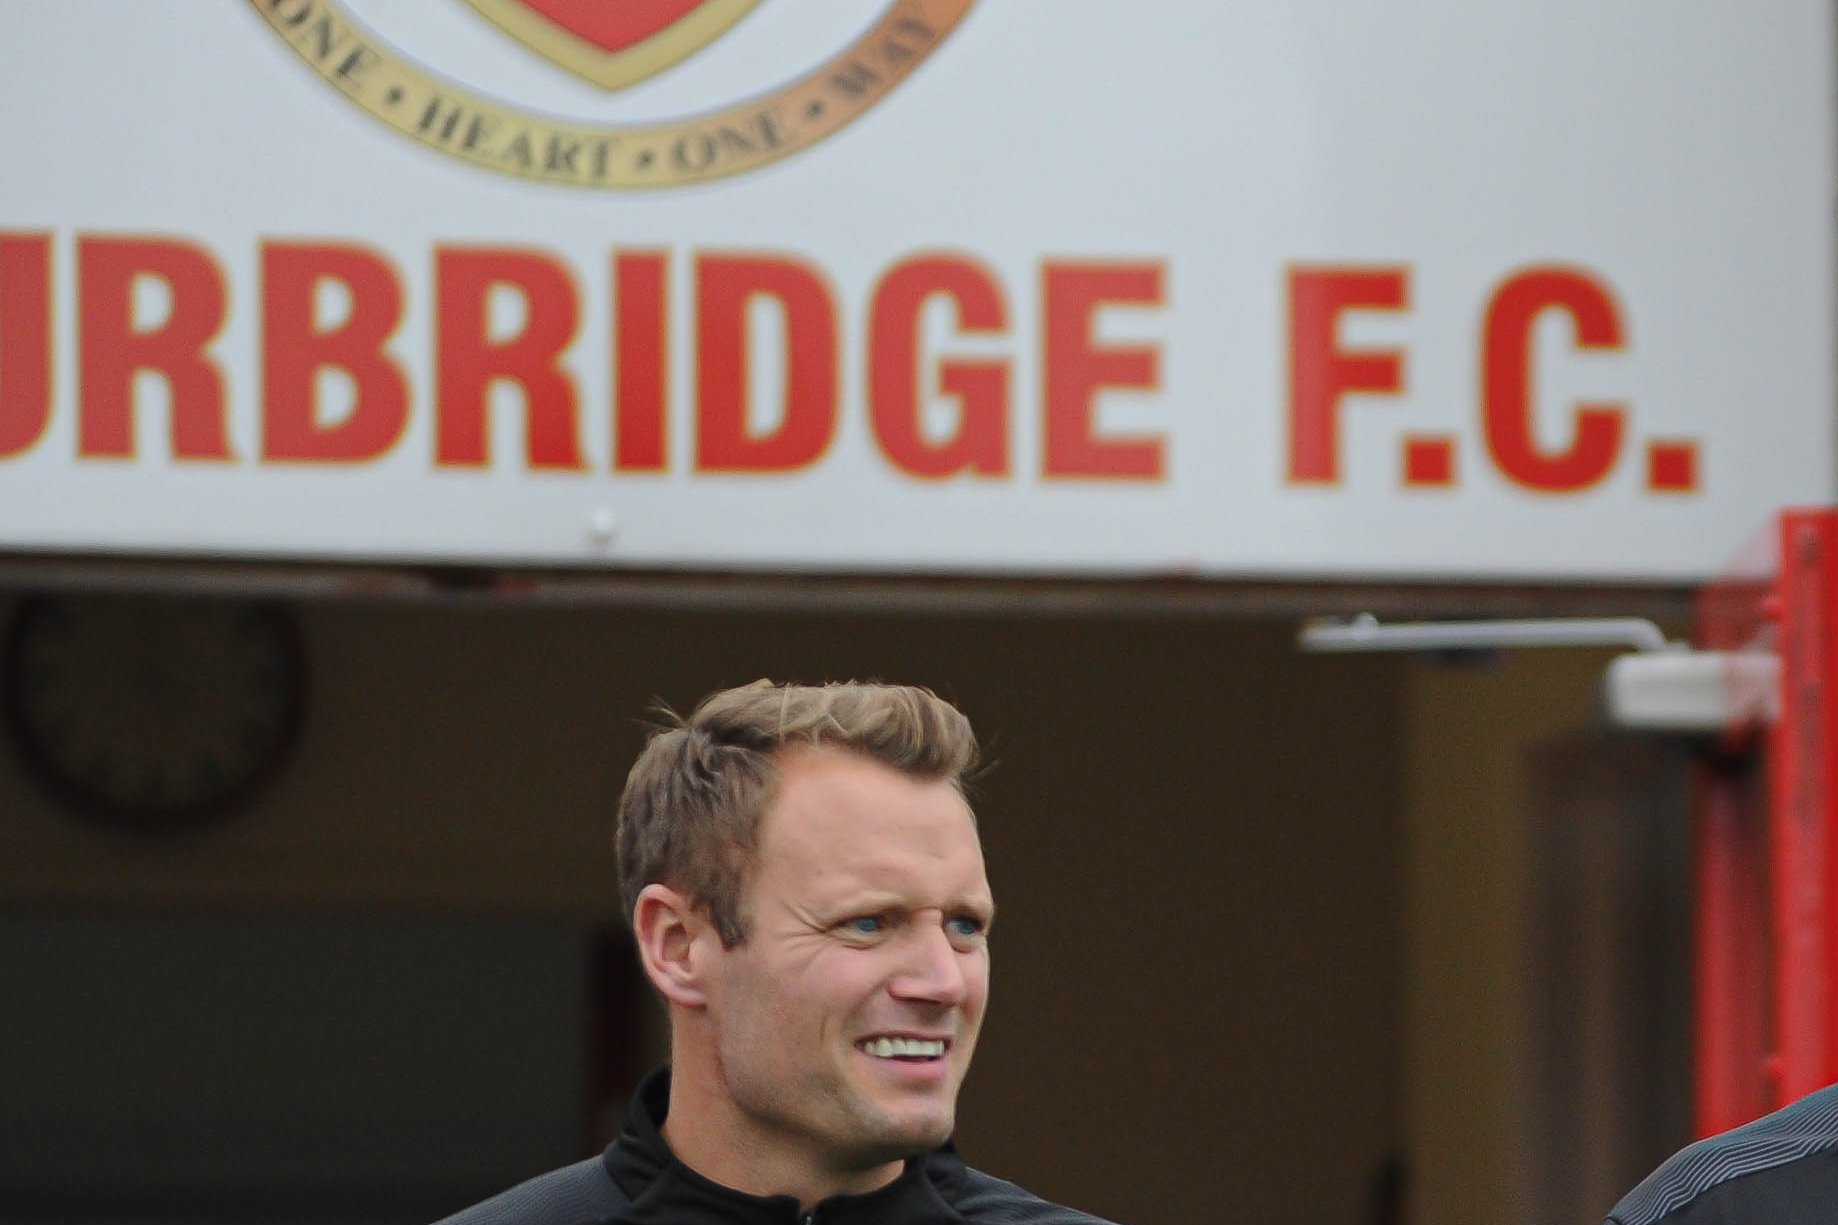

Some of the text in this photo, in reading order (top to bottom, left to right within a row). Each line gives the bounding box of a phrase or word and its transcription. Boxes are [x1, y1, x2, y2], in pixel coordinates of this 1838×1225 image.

[414, 96, 618, 179] HEART
[671, 106, 792, 172] ONE
[1283, 260, 1702, 494] F.C.
